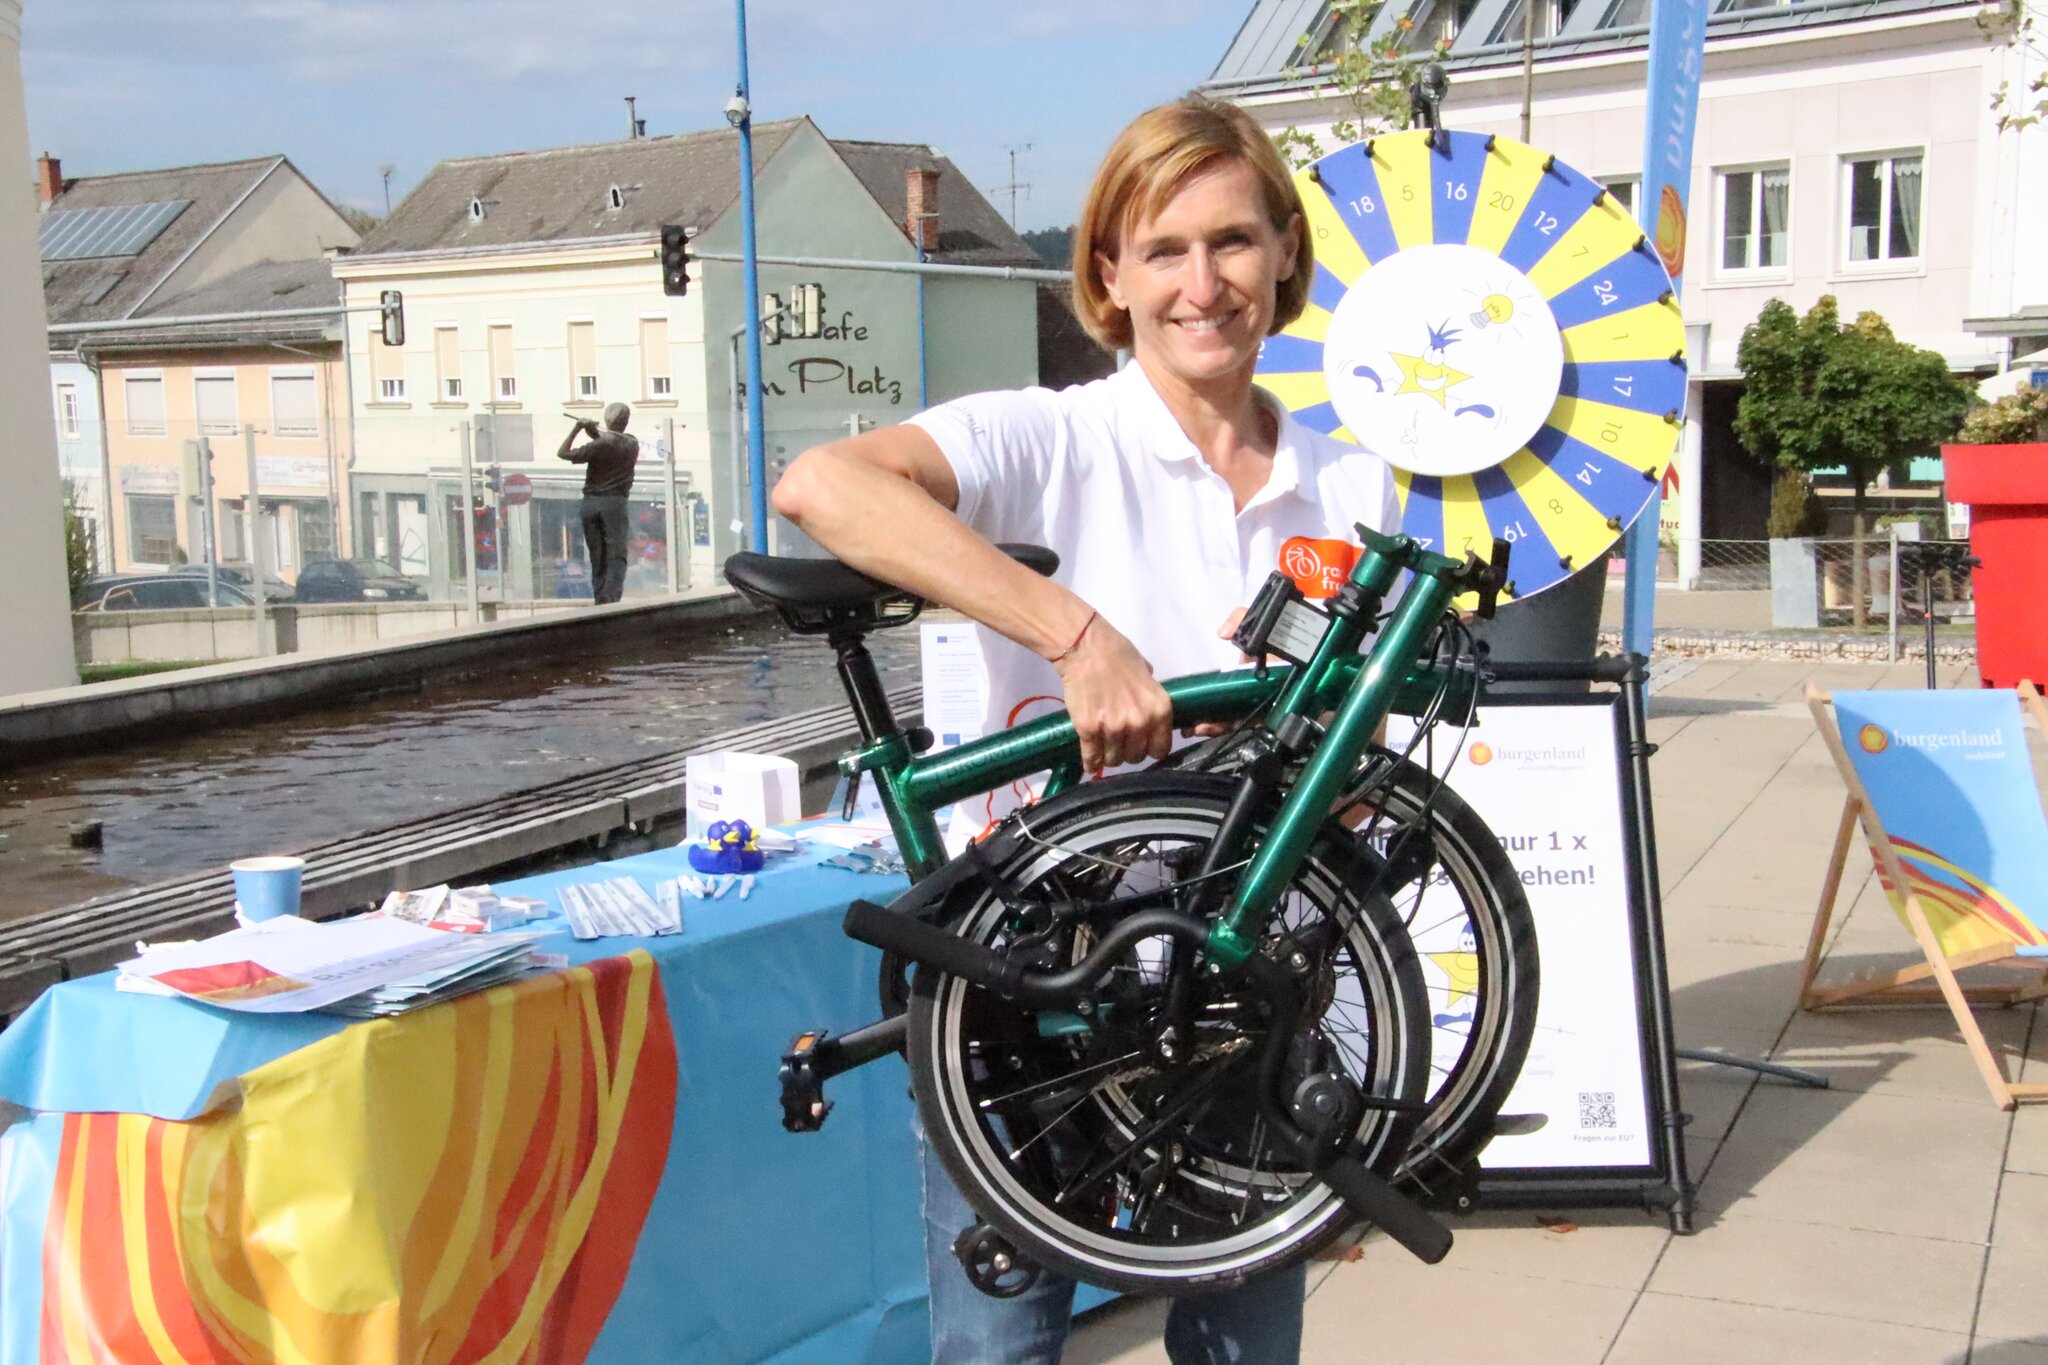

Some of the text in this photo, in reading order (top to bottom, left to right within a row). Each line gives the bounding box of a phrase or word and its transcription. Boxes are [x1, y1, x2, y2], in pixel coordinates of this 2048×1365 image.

[1402, 184, 1415, 202] 5
[1446, 181, 1468, 201] 16
[1489, 191, 1514, 212] 20
[1350, 196, 1375, 217] 18
[1316, 224, 1329, 239] 6
[1534, 210, 1558, 236] 12
[1571, 245, 1589, 258] 7
[1593, 280, 1619, 306] 24
[788, 357, 902, 405] Platz
[1613, 375, 1633, 398] 17
[1601, 422, 1623, 443] 10
[1576, 462, 1602, 486] 14
[1548, 499, 1563, 514] 8
[1504, 521, 1528, 544] 19
[1893, 728, 2003, 751] burgenland
[1497, 747, 1587, 762] burgenland
[1547, 831, 1562, 851] 1
[1572, 835, 1587, 851] x
[1516, 864, 1595, 885] ehen!
[1573, 1134, 1601, 1143] Fragen
